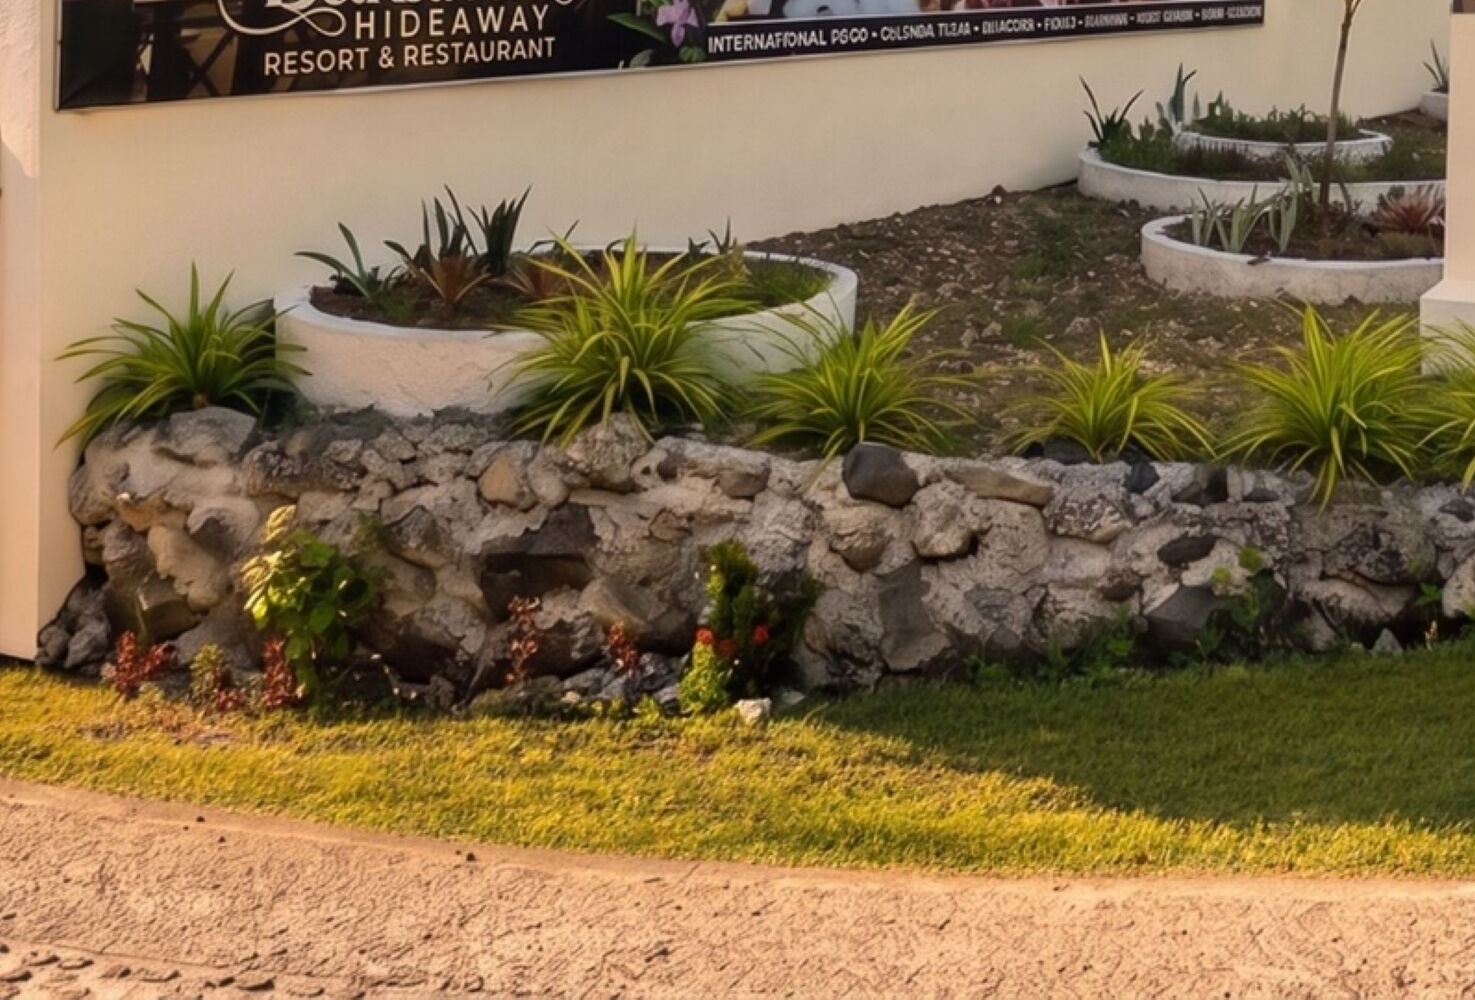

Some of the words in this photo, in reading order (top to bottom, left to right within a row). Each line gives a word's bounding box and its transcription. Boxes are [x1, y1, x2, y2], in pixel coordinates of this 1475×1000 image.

[354, 3, 550, 41] HIDEAWAY
[264, 46, 370, 76] RESORT
[379, 44, 395, 69] &
[404, 36, 555, 67] RESTAURANT
